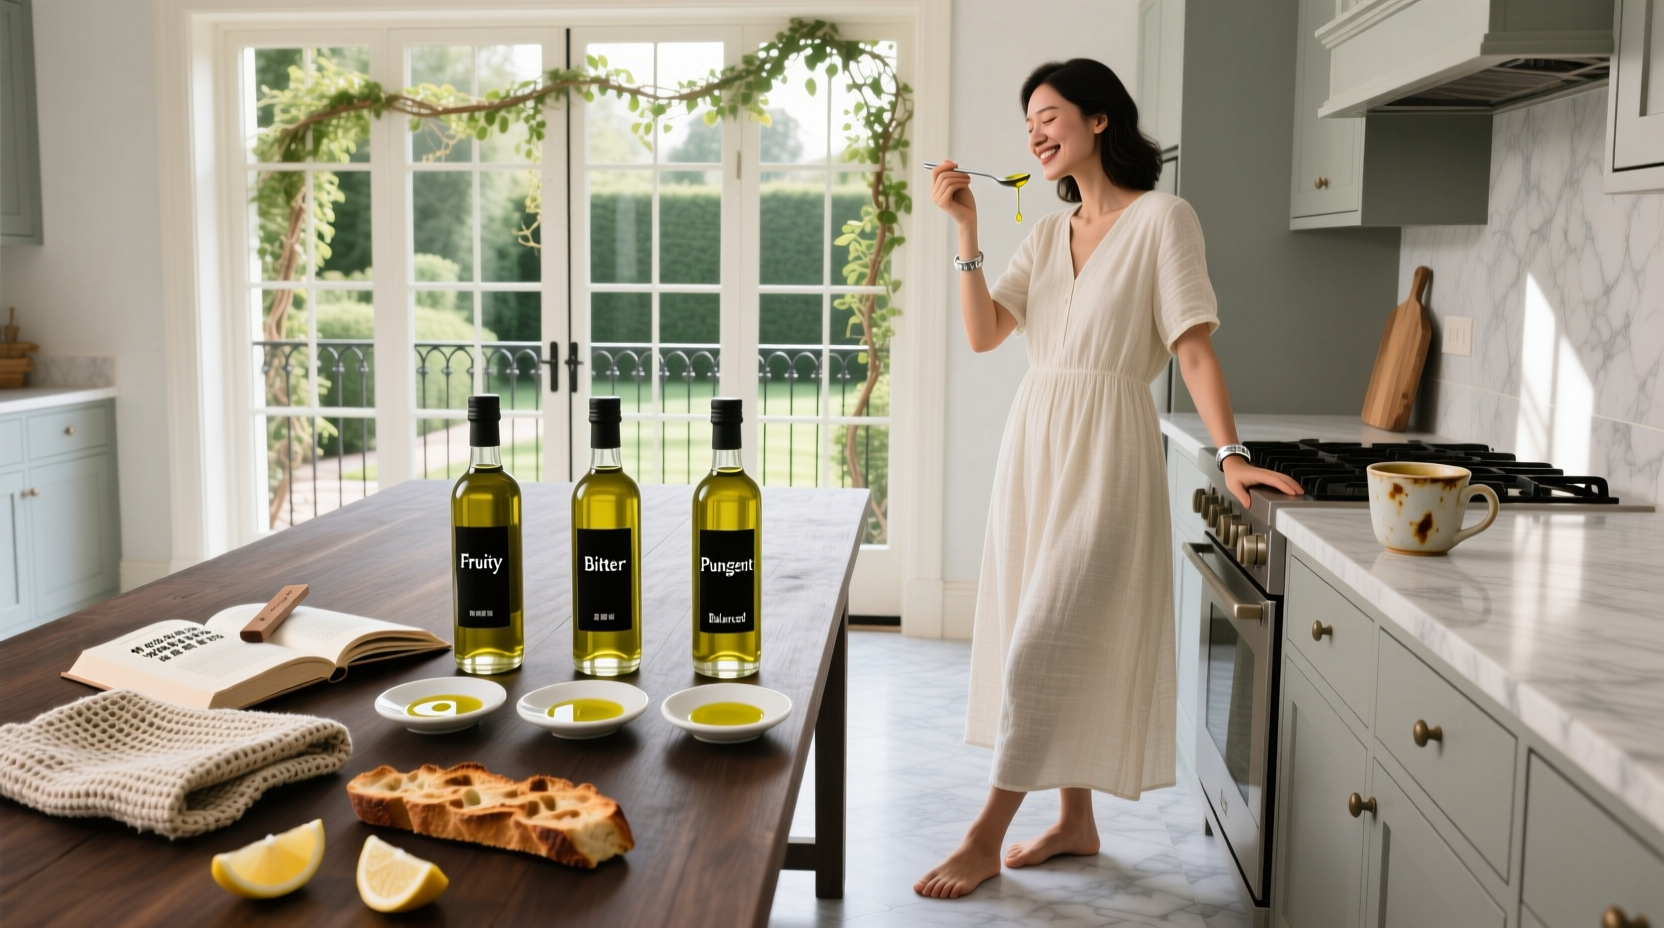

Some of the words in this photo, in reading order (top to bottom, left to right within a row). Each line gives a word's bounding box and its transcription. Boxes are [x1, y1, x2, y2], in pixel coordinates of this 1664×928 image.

[460, 552, 503, 575] Fruity
[584, 555, 627, 573] Bitter
[700, 556, 754, 577] Pungent
